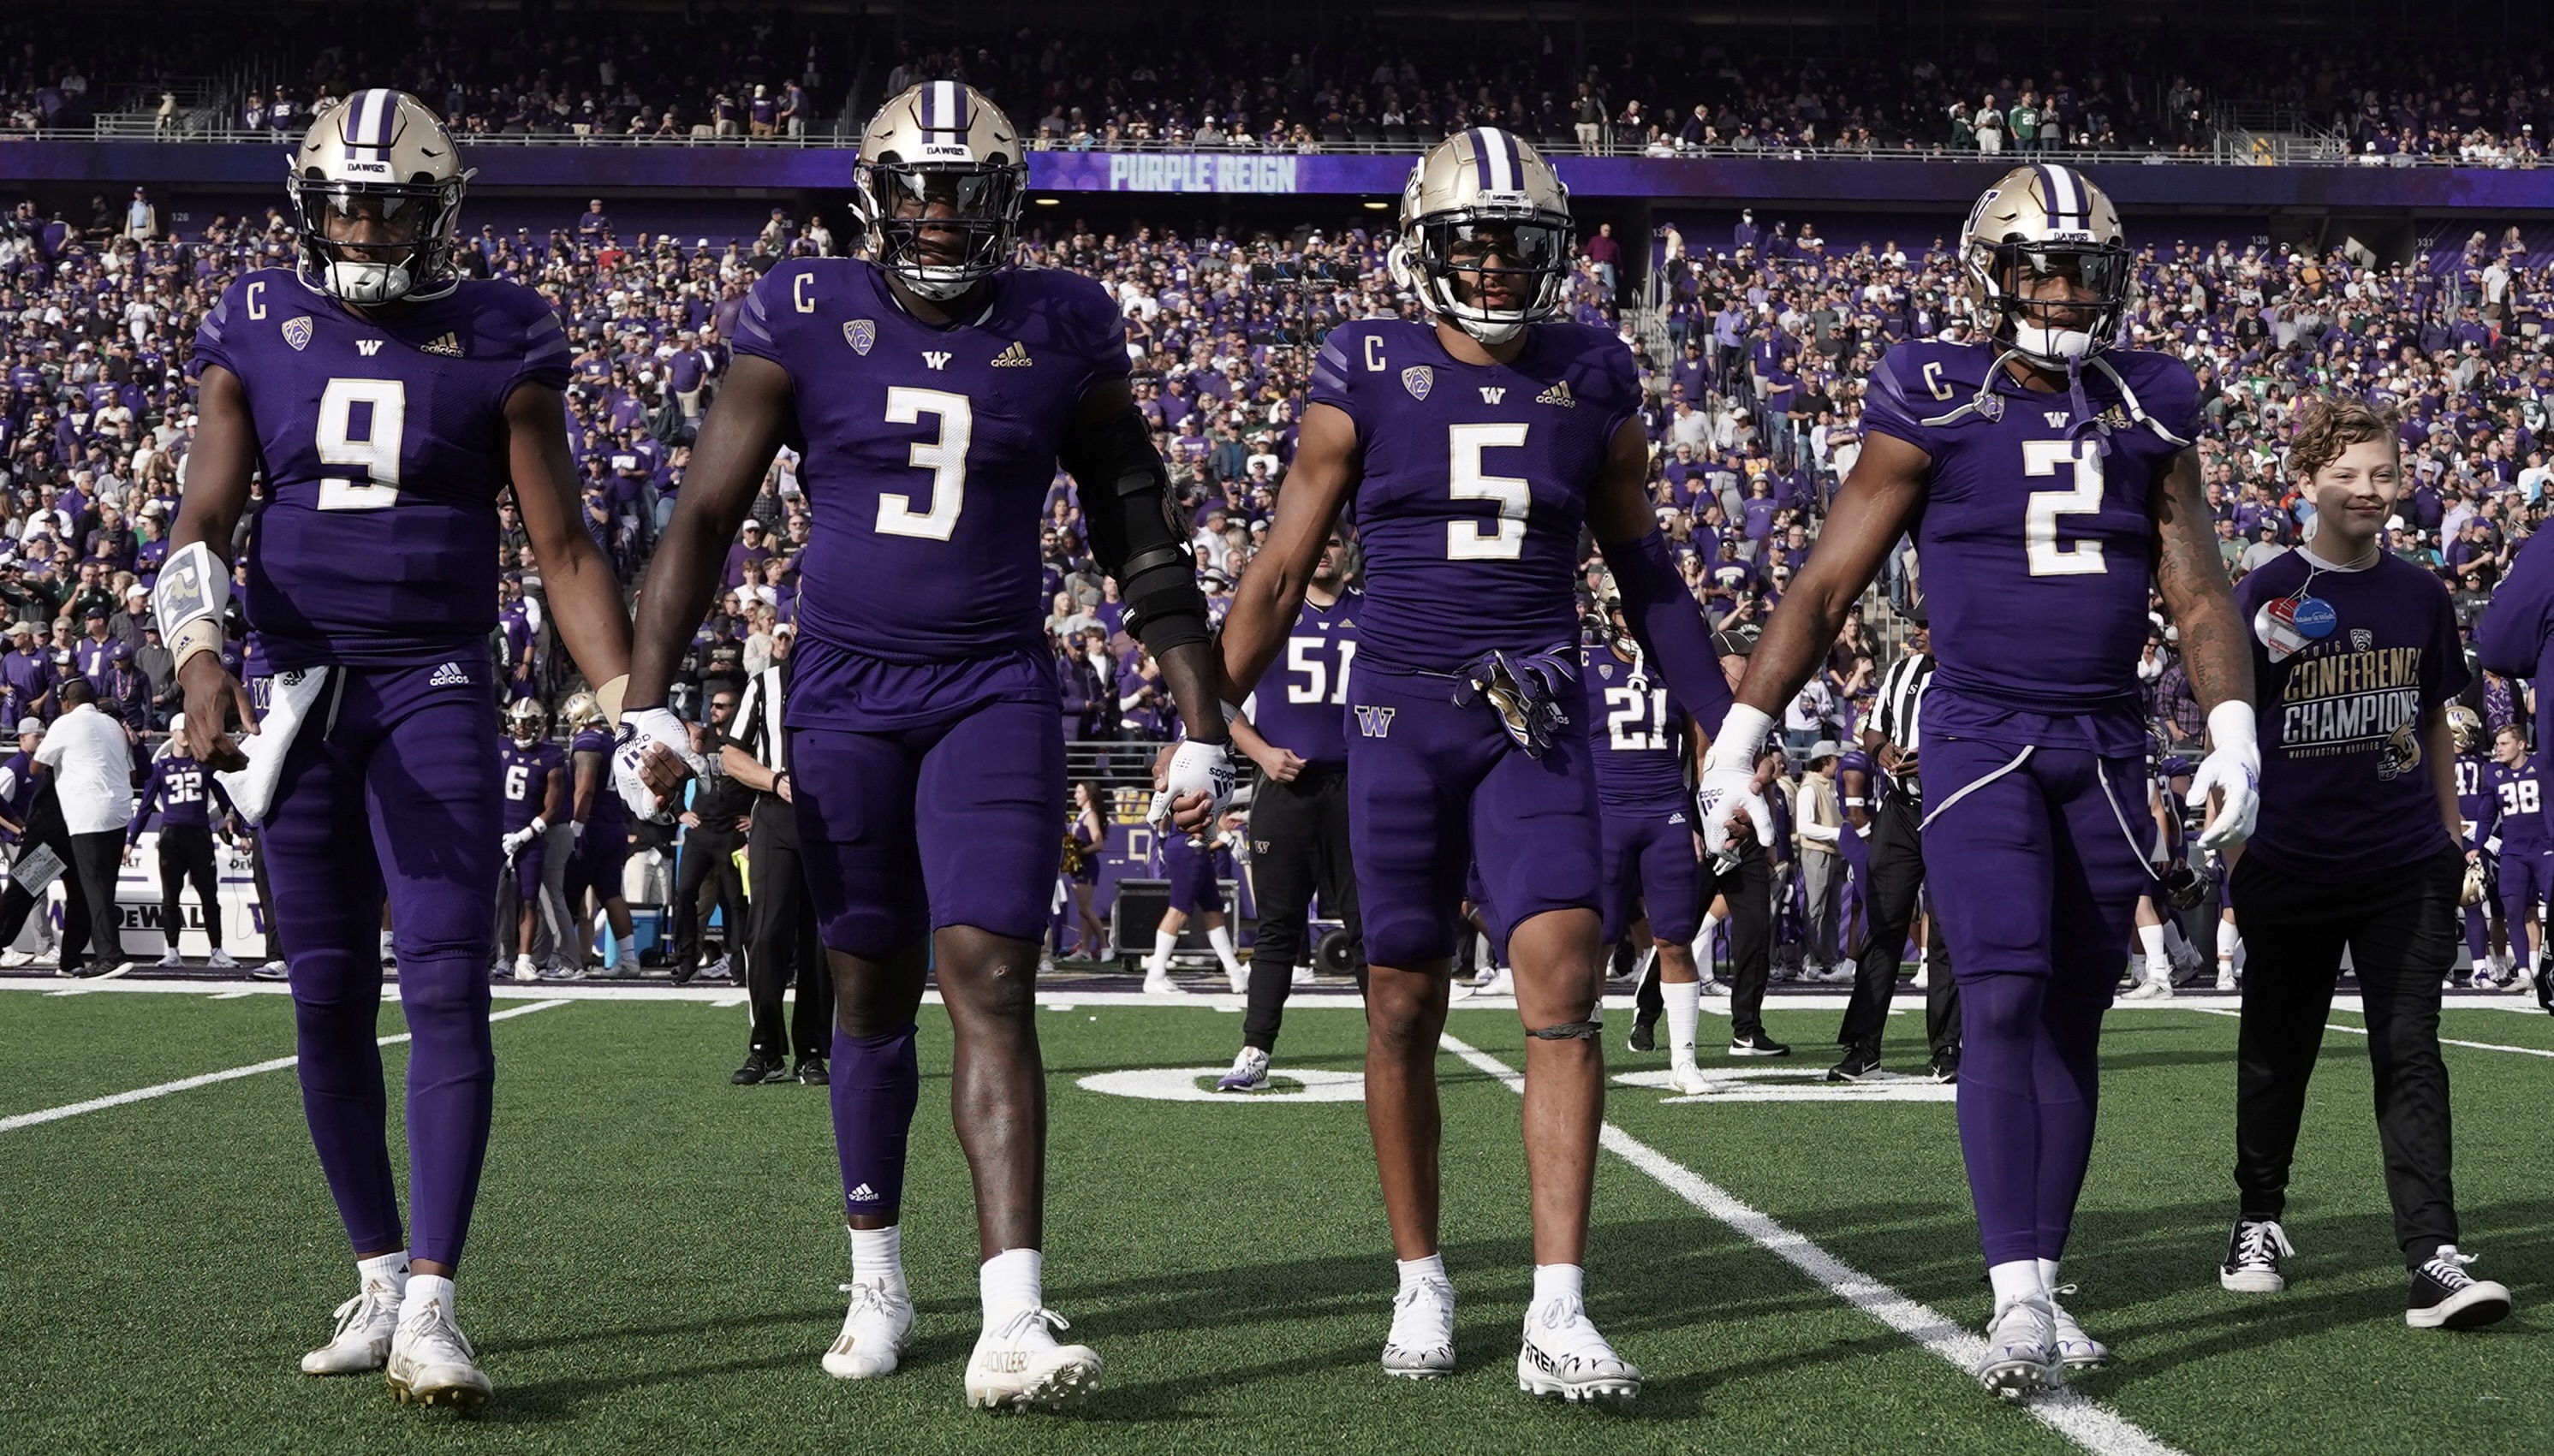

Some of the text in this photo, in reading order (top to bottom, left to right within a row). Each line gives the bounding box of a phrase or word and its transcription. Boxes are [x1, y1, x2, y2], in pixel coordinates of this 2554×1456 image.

[274, 104, 291, 117] 25
[2021, 113, 2036, 127] 20
[926, 146, 965, 156] DAWGS
[348, 163, 386, 173] DAWGS
[1110, 153, 1296, 193] PURPLE REIGN
[172, 213, 189, 223] 128
[780, 219, 793, 229] 28
[1652, 228, 1666, 238] 13
[2251, 235, 2269, 245] 130
[2417, 238, 2433, 247] 131
[247, 282, 266, 320] C
[794, 272, 815, 313] C
[355, 340, 383, 356] W
[420, 343, 465, 358] adidas
[1365, 335, 1386, 371] C
[921, 351, 952, 370] W
[991, 356, 1033, 367] adidas
[1923, 361, 1954, 401] C
[1479, 387, 1506, 405] W
[1535, 394, 1576, 408] adidas
[2044, 411, 2070, 428] W
[315, 377, 406, 510] 9
[874, 386, 973, 542] 3
[1447, 423, 1531, 560] 5
[2021, 440, 2108, 576] 2
[2301, 640, 2341, 658] 2016
[88, 651, 100, 676] 1
[1288, 637, 1357, 704] 51
[429, 674, 469, 686] adidas
[253, 678, 274, 709] W
[1908, 684, 1919, 695] S
[1354, 705, 1396, 737] W
[1604, 686, 1667, 750] 21
[2283, 691, 2420, 744] CHAMPIONS
[2450, 711, 2465, 722] W
[505, 765, 528, 800] 6
[2455, 762, 2479, 796] 47
[165, 772, 203, 805] 32
[2498, 779, 2540, 817] 38
[1254, 840, 1270, 854] W
